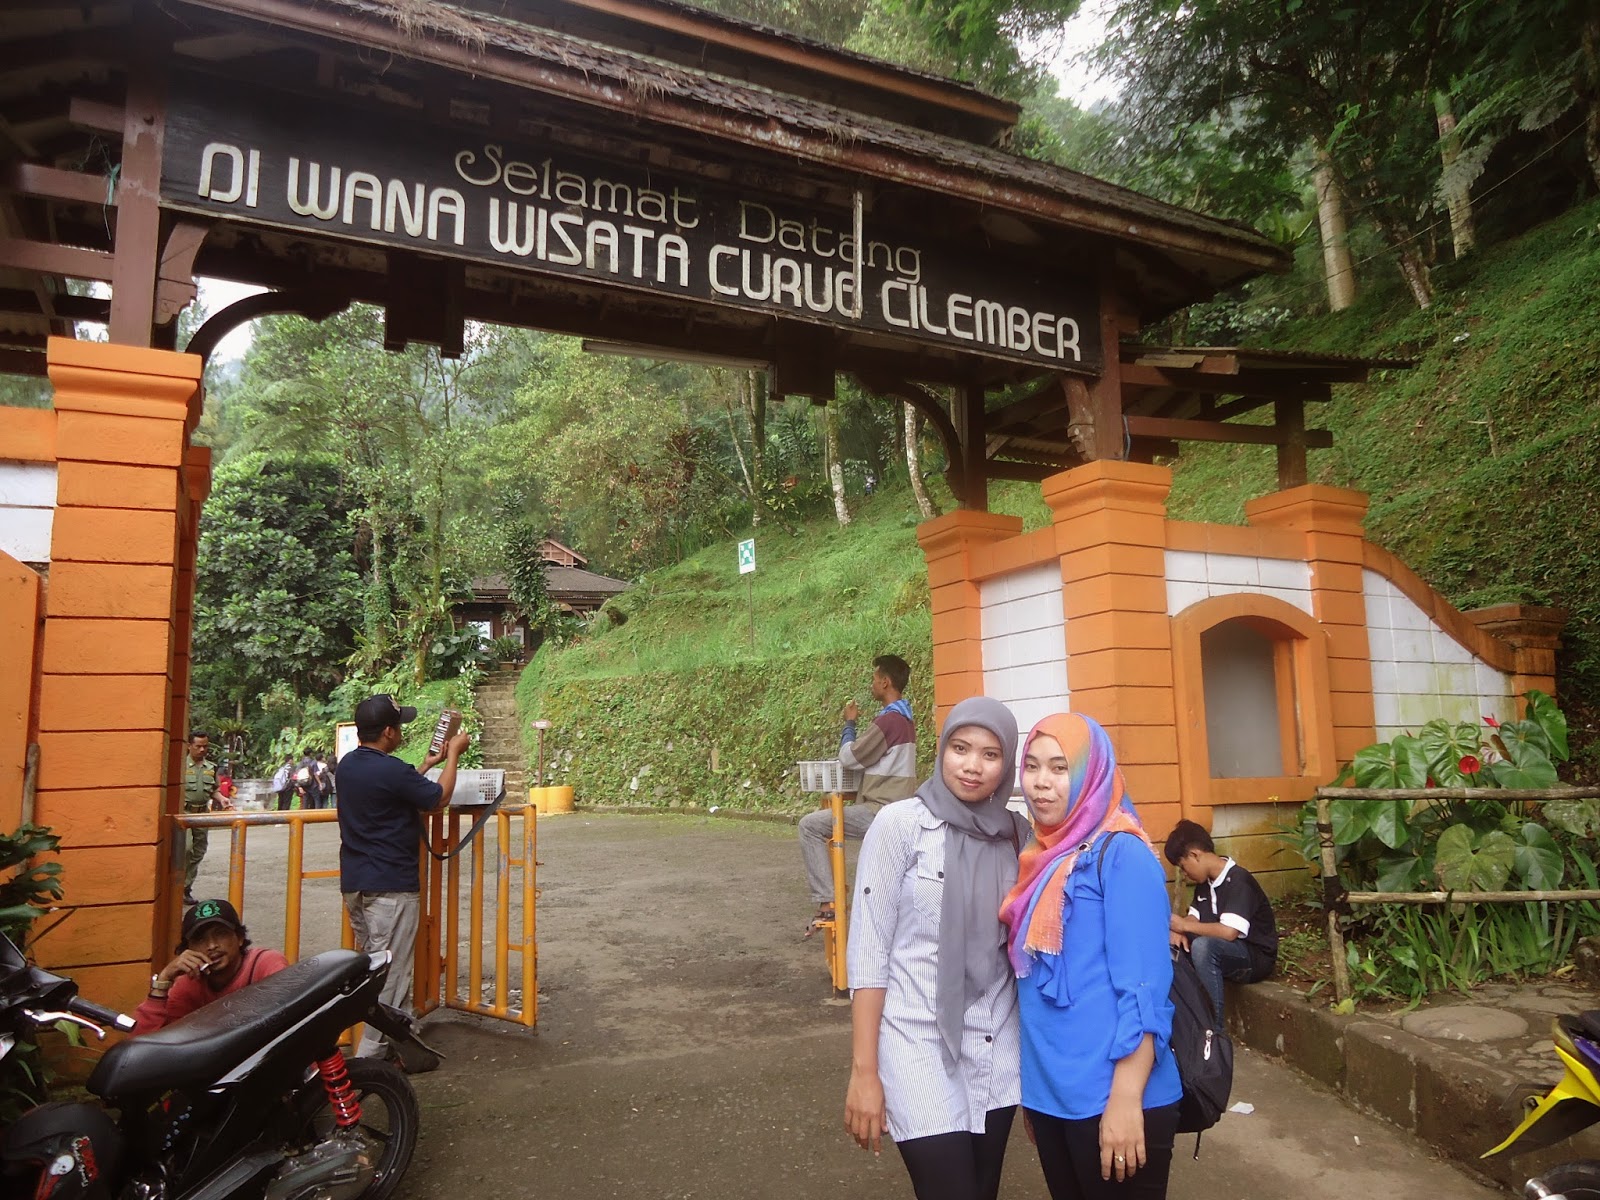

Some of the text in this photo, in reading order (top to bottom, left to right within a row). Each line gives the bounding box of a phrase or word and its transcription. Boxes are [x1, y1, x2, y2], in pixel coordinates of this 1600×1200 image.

[198, 142, 261, 208] DI
[286, 157, 465, 246] WANA
[489, 197, 690, 288] WISATA
[882, 279, 1081, 362] CILEMBER
[455, 144, 921, 284] Selamat Datang
